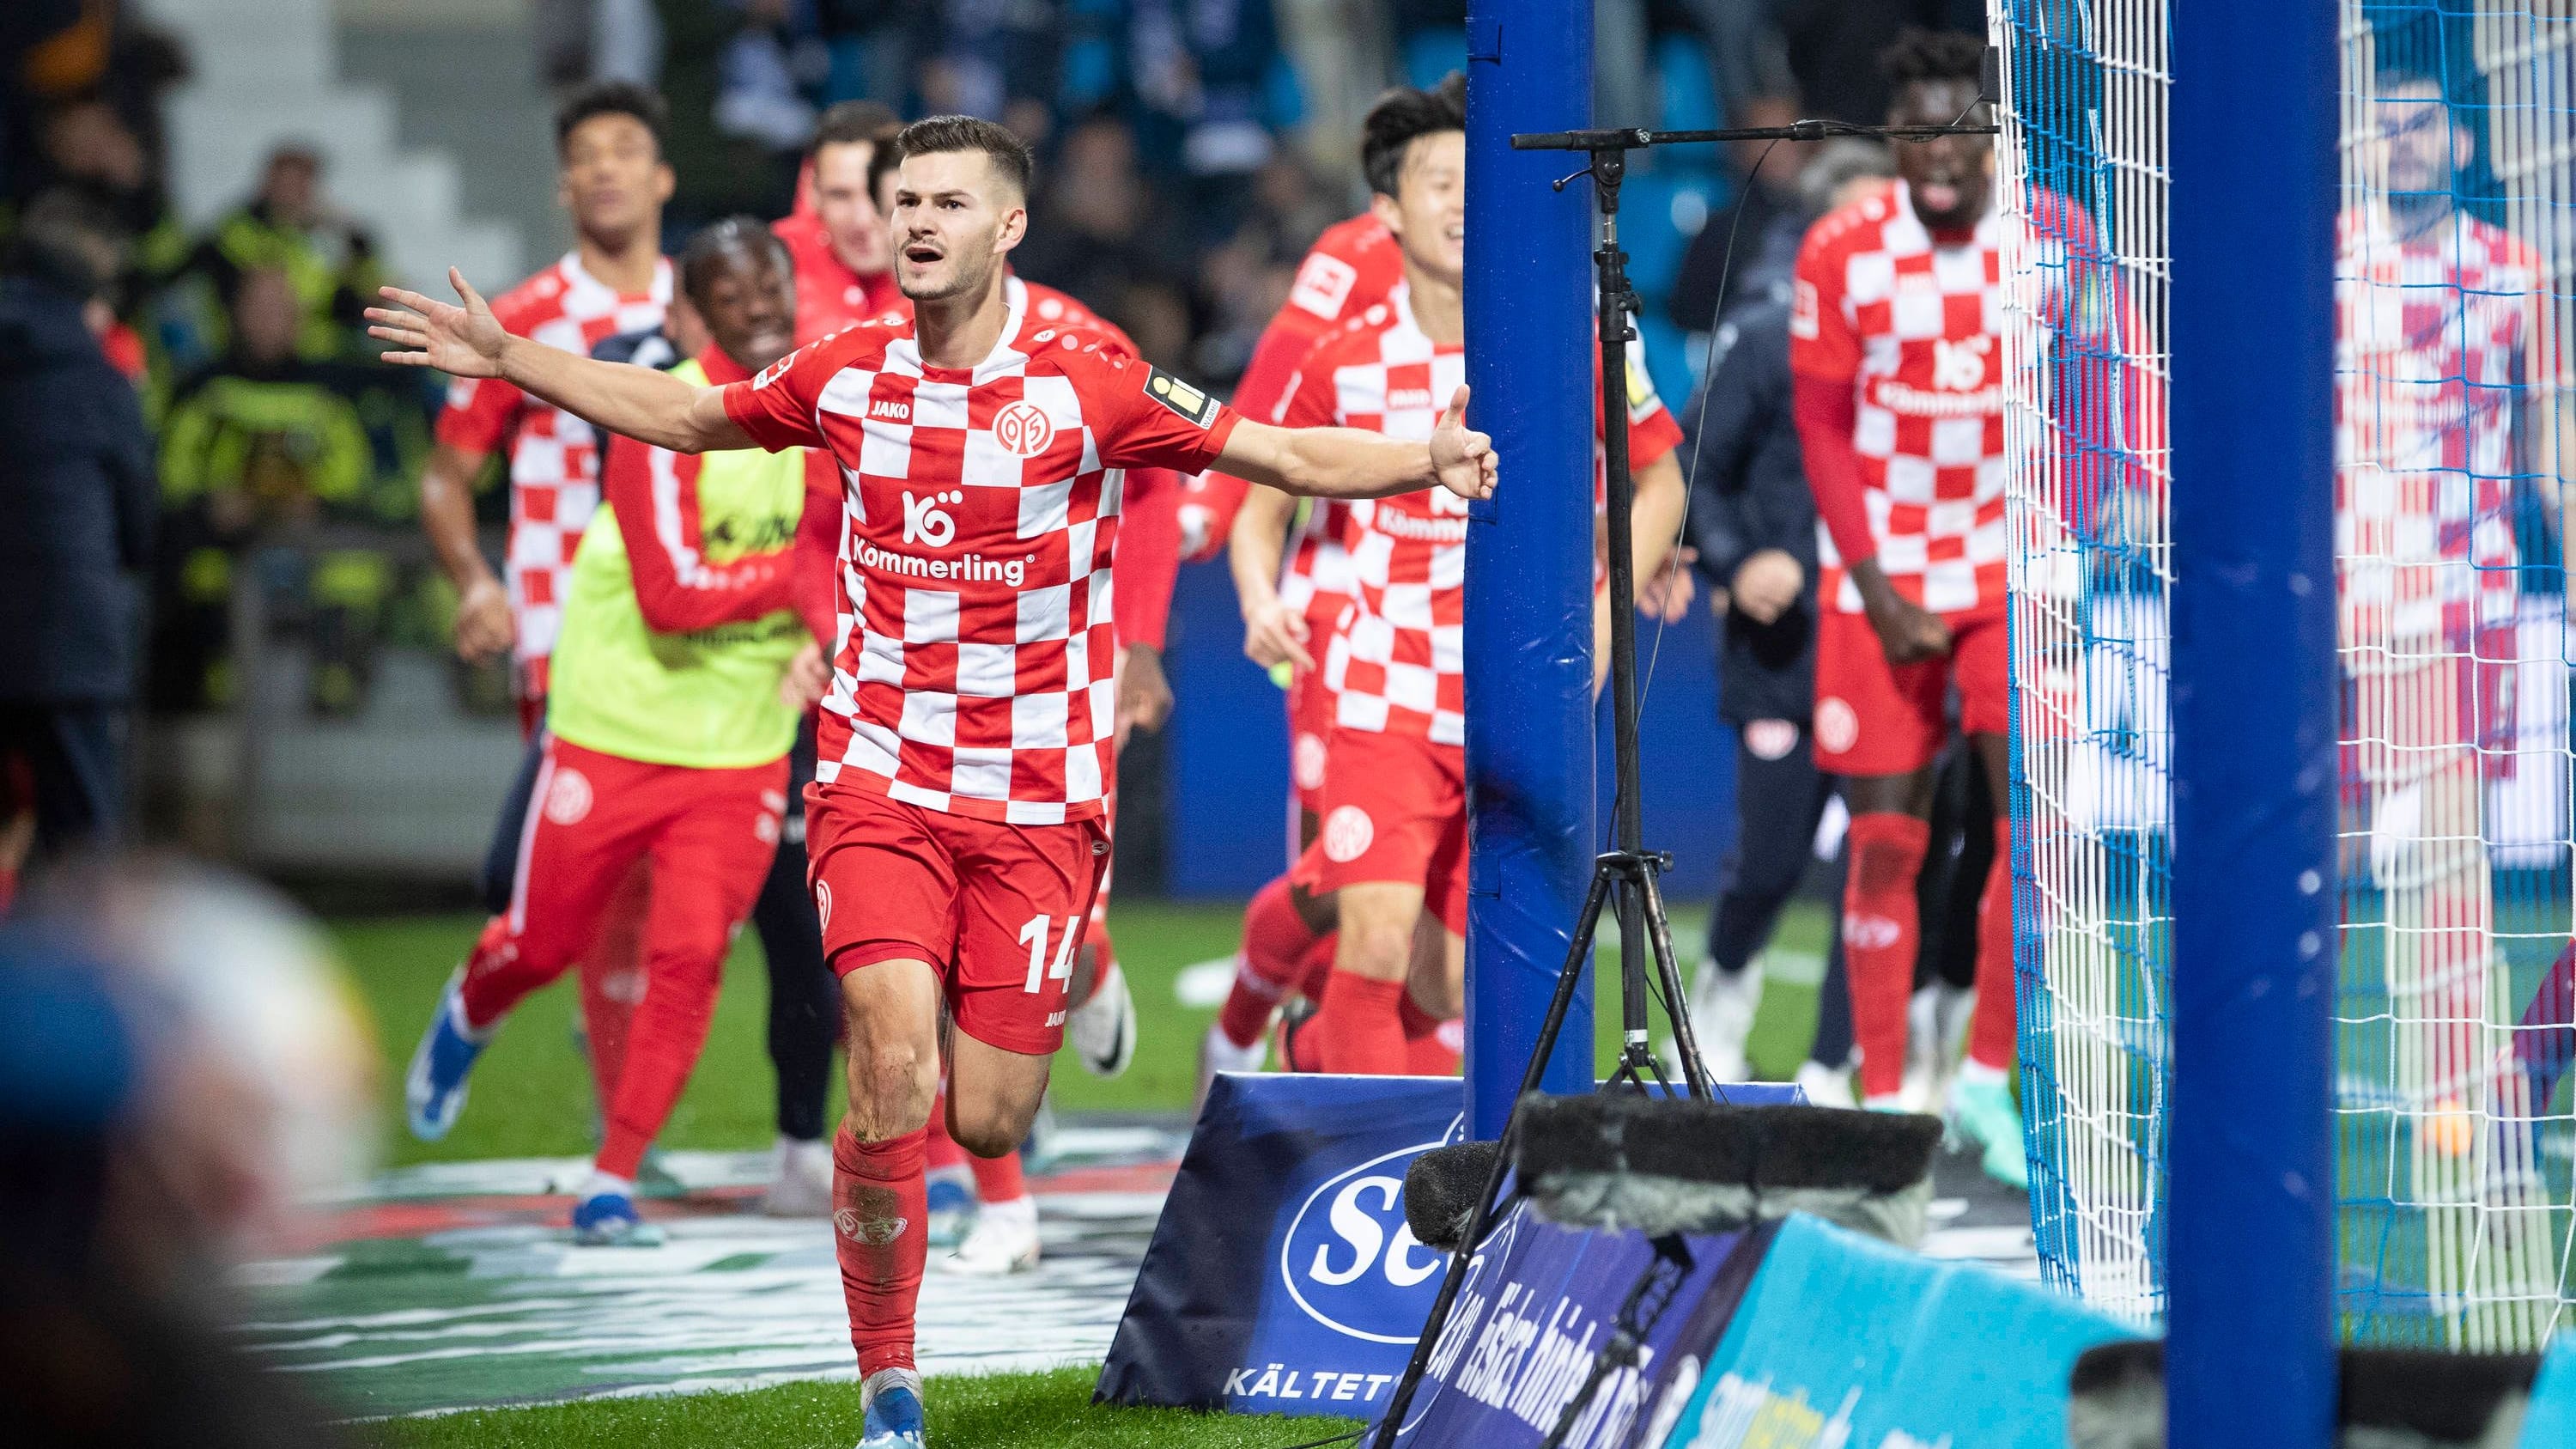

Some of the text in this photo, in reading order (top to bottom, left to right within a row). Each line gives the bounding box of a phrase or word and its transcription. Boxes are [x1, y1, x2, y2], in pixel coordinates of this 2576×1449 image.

[872, 400, 910, 419] JAKO
[1377, 503, 1468, 541] Kömm
[1019, 913, 1080, 994] 14
[1222, 1362, 1406, 1402] KÄLTET
[1507, 1295, 1597, 1439] hinte
